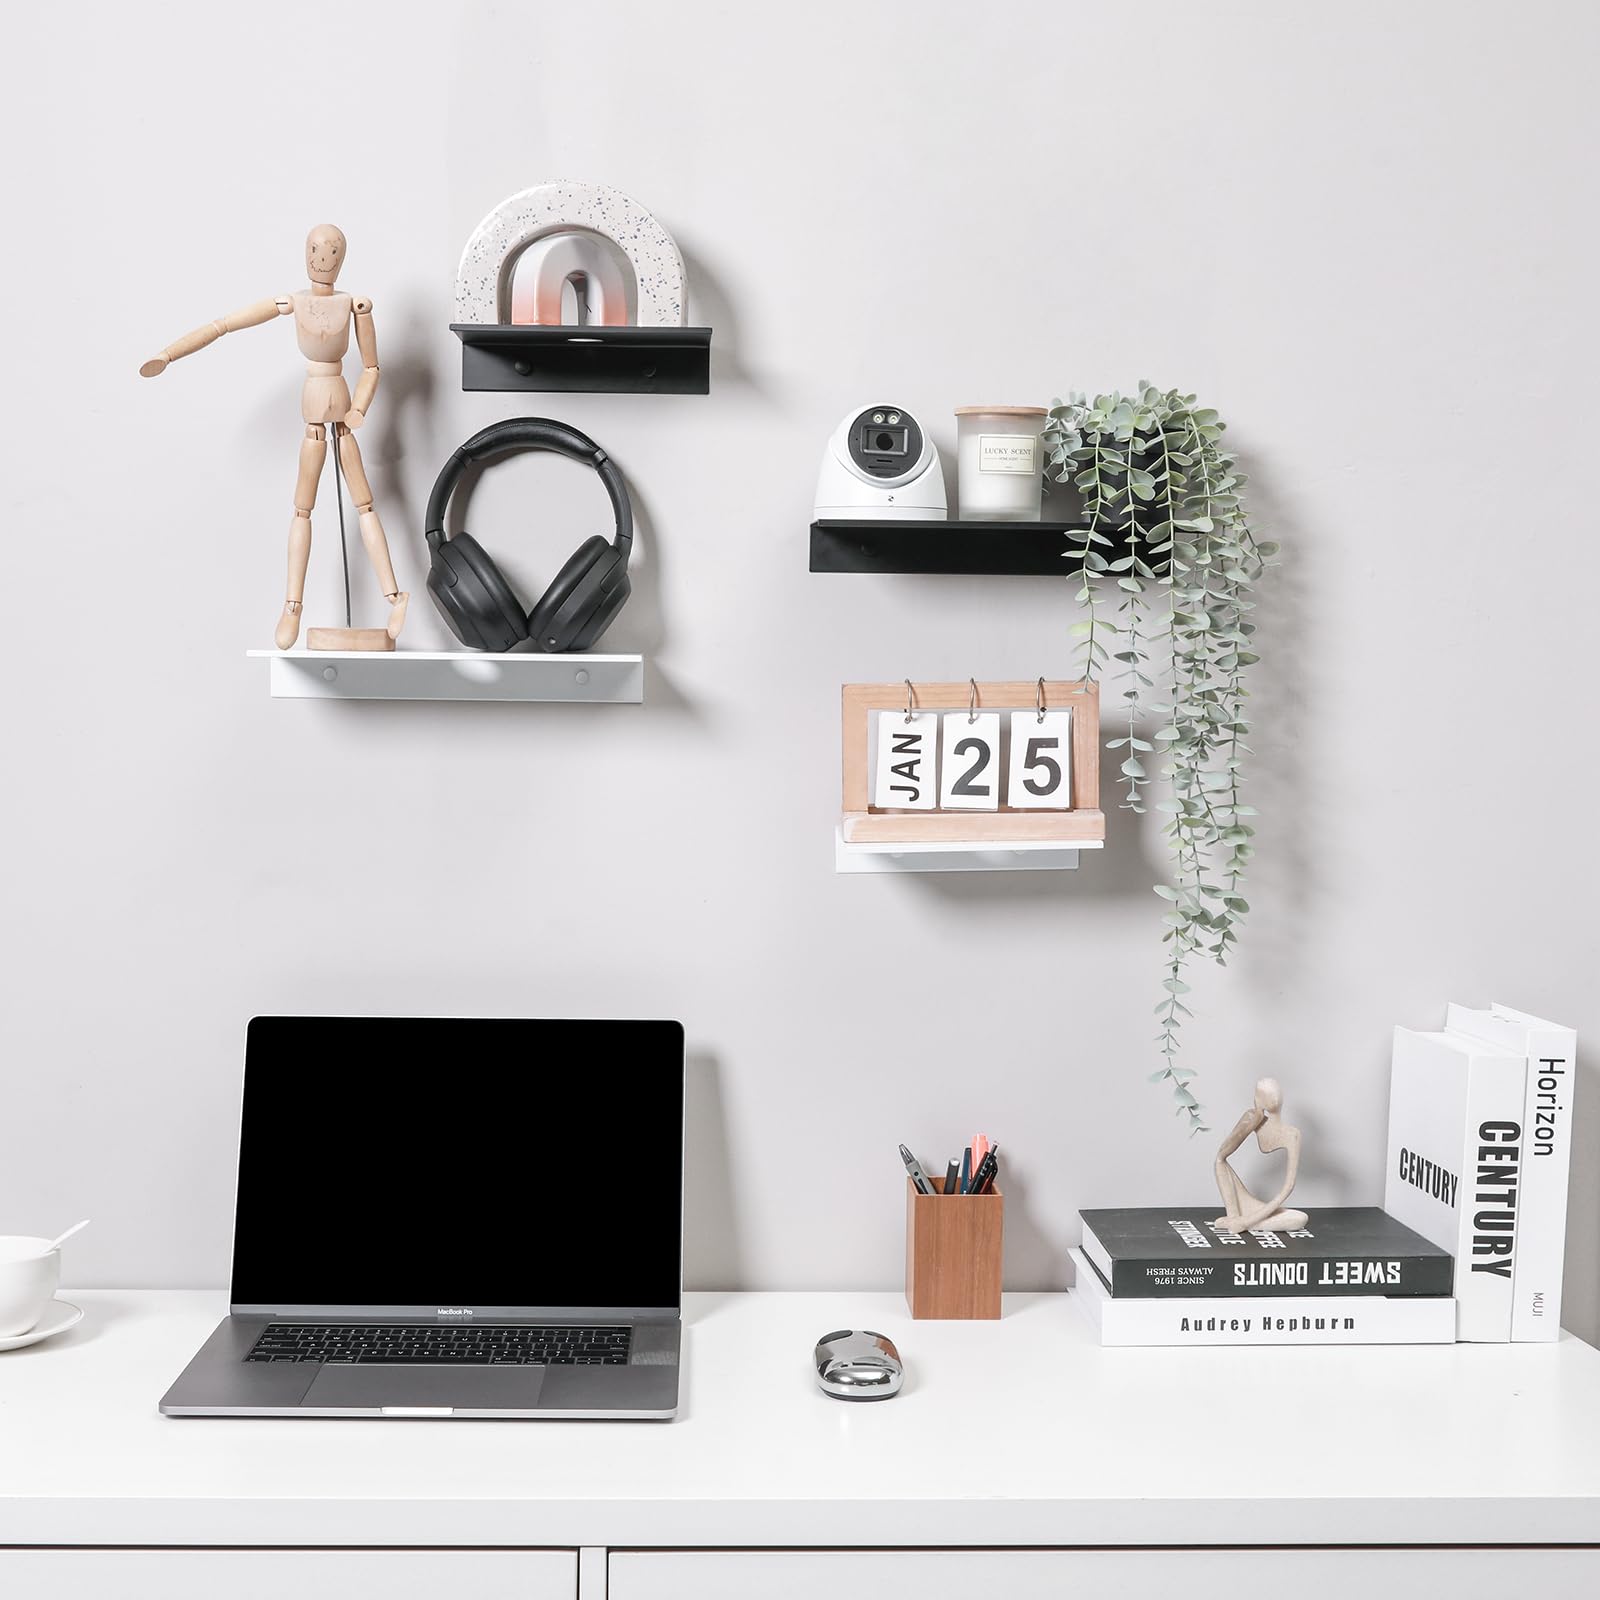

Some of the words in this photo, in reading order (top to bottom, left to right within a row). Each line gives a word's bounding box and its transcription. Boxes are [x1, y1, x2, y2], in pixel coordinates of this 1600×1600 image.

[985, 447, 1009, 455] LUCKY
[1010, 447, 1032, 456] SCENT
[890, 734, 922, 801] JAN
[951, 737, 991, 796] 2
[1023, 737, 1062, 796] 5
[1534, 1058, 1566, 1156] Horizon
[1400, 1147, 1459, 1209] CENTURY
[1471, 1120, 1521, 1279] CENTURY
[1146, 1267, 1176, 1276] FRESH
[1154, 1276, 1175, 1285] 1976
[1177, 1267, 1214, 1276] ALWAYS
[1177, 1276, 1205, 1285] SINCE
[1233, 1262, 1308, 1286] DONUTS
[1318, 1261, 1401, 1285] SWEET
[1532, 1292, 1545, 1317] MUJI
[1180, 1317, 1251, 1333] Audrey
[1262, 1316, 1355, 1332] Hepburn
